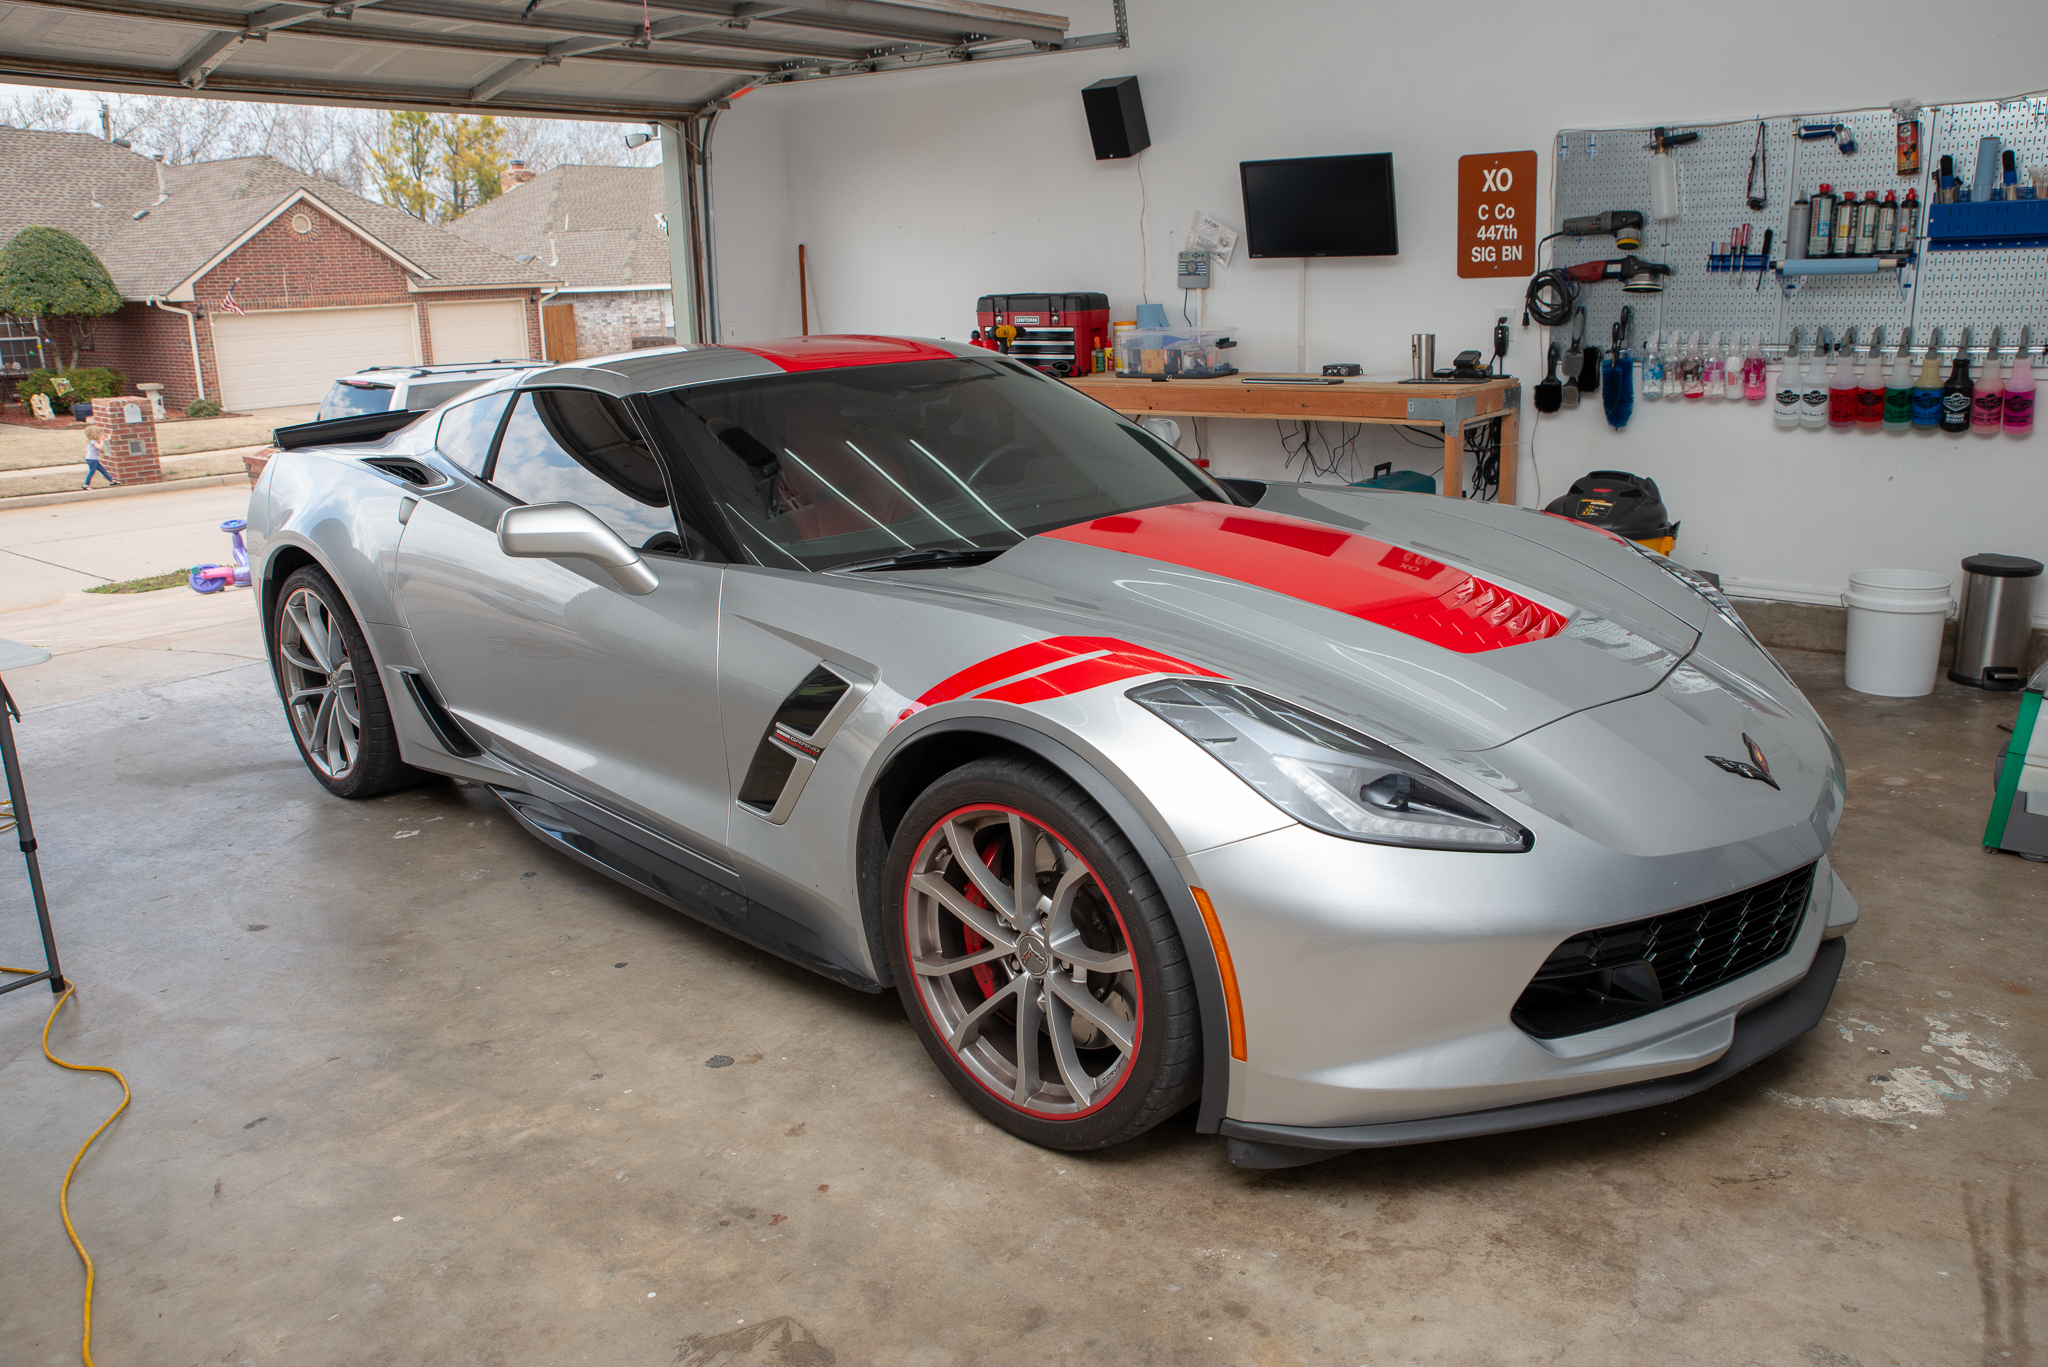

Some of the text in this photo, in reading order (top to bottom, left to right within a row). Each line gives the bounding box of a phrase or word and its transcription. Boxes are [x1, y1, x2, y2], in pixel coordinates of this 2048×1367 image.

[1482, 168, 1513, 192] XO
[1478, 203, 1515, 220] C Co
[1477, 224, 1518, 241] 447th
[1820, 222, 1829, 235] SF
[1471, 245, 1522, 263] SIG BN
[1749, 372, 1757, 387] PREP
[788, 740, 818, 756] SPORT
[790, 736, 820, 753] GRAND
